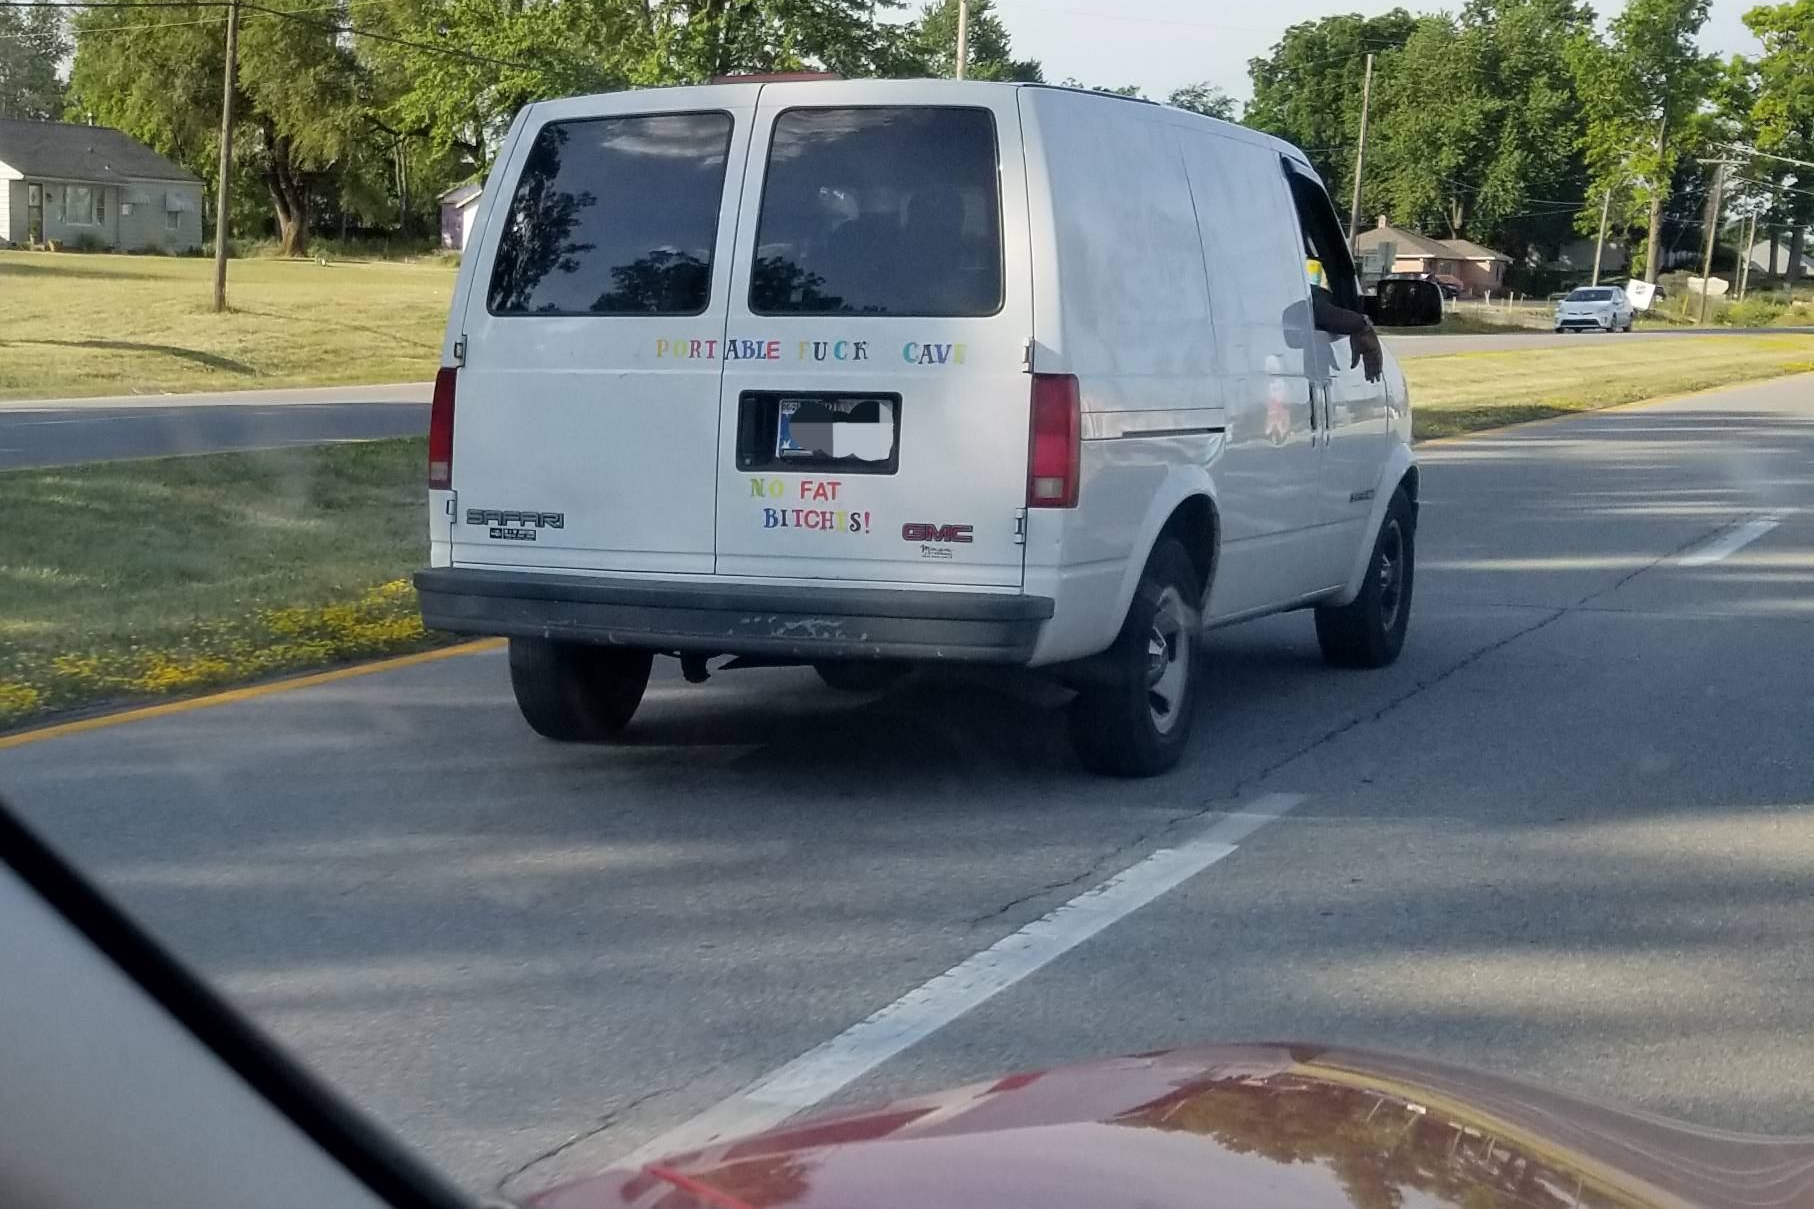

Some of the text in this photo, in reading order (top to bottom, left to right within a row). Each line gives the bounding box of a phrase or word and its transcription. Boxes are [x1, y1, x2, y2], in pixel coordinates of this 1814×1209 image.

[798, 340, 868, 361] FUCK
[902, 341, 967, 365] CAVE
[750, 478, 842, 501] NO FAT
[466, 508, 565, 529] SAFARI
[763, 508, 871, 534] BITCHES!
[902, 523, 974, 543] GMC
